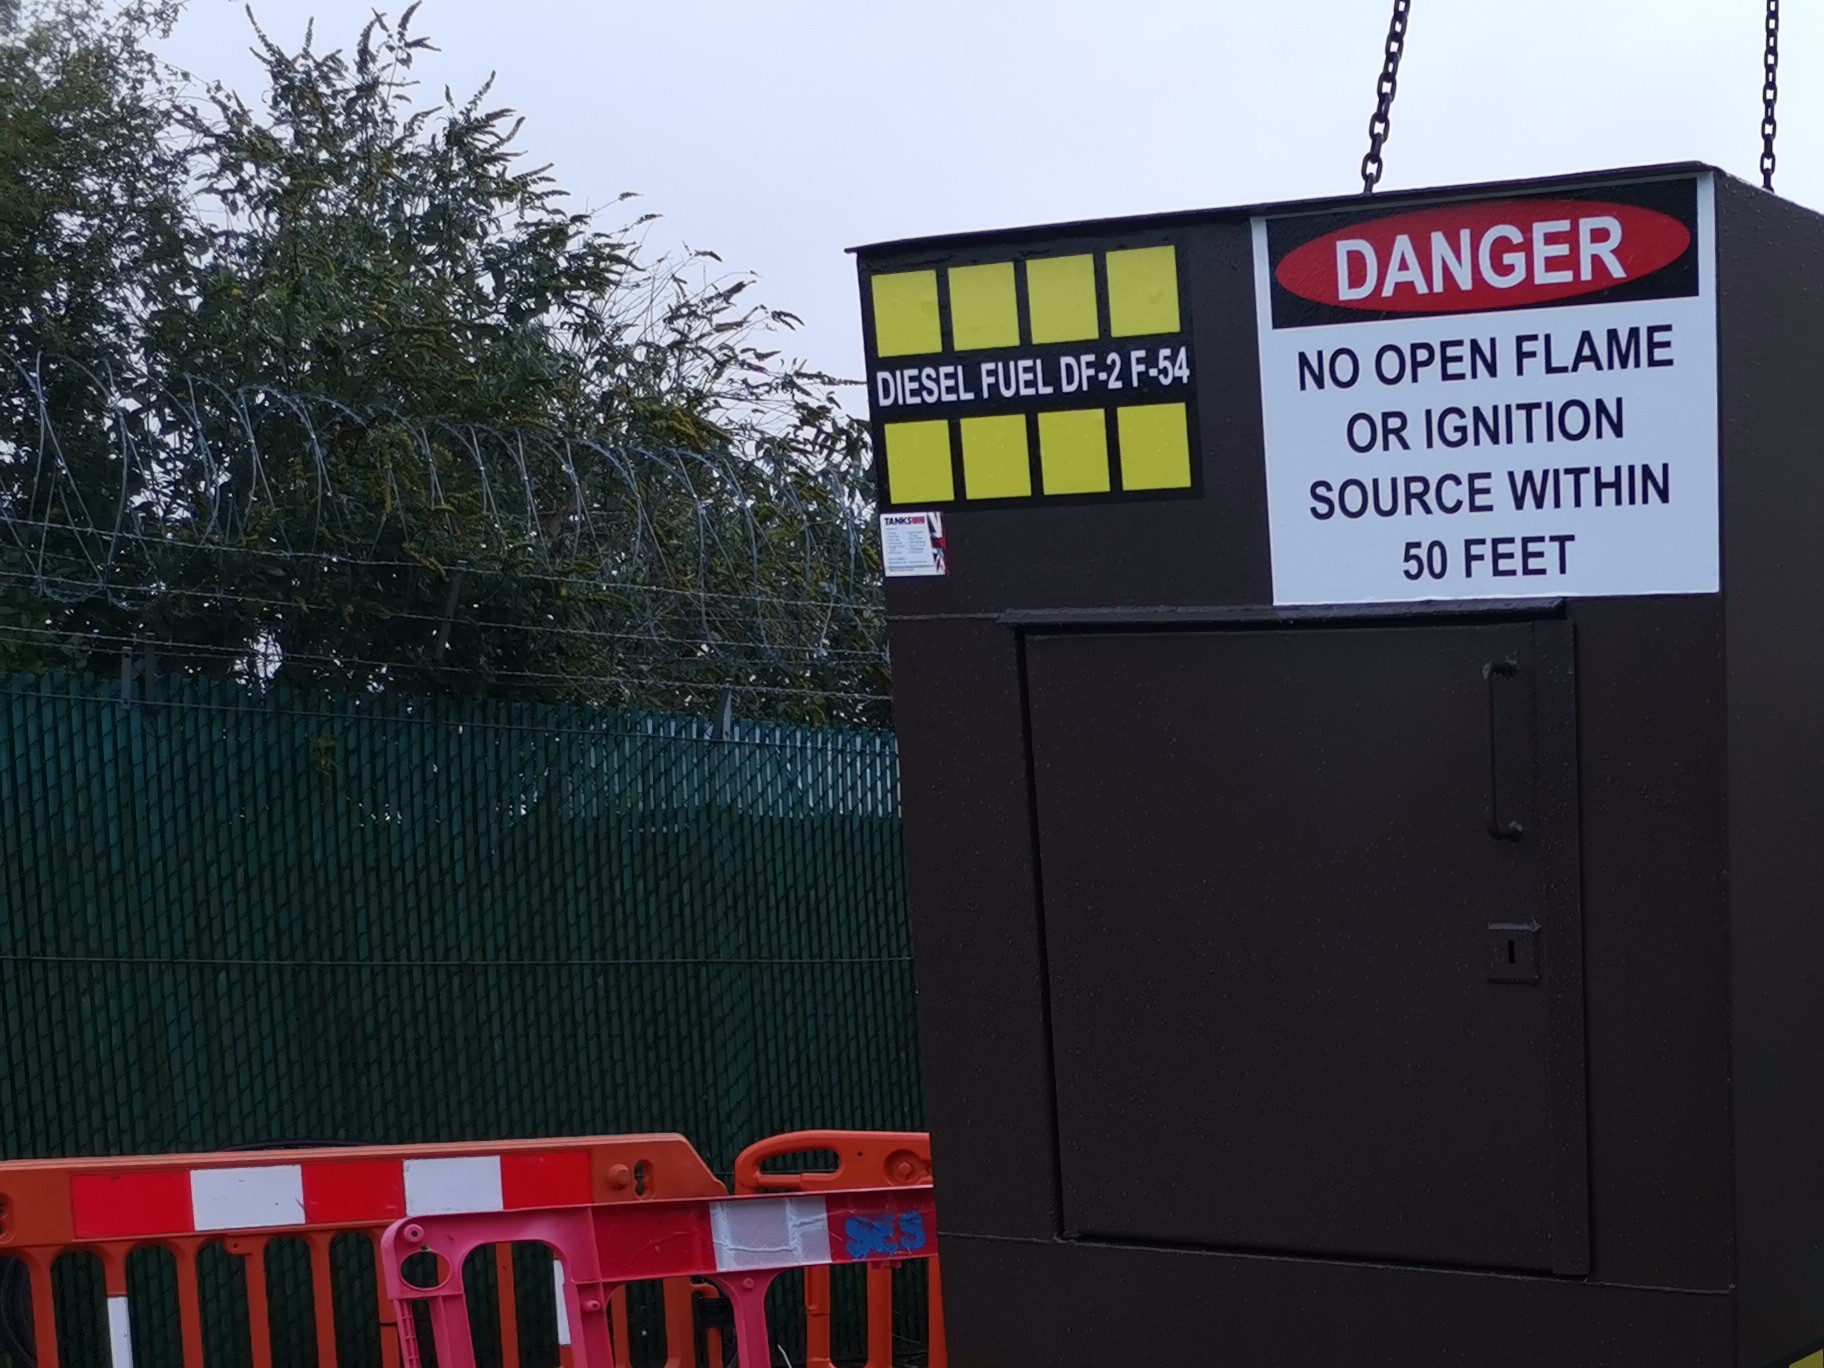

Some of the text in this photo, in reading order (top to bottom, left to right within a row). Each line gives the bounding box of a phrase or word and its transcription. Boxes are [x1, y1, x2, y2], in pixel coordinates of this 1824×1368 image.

[1335, 215, 1628, 301] DANGER
[876, 346, 1191, 407] DIESEL FUEL DF-2 F-54
[1298, 323, 1674, 391] NO OPEN FLAME
[1346, 396, 1624, 453] OR IGNITION
[1309, 462, 1671, 520] SOURCE WITHIN
[1402, 534, 1576, 581] 50 FEET
